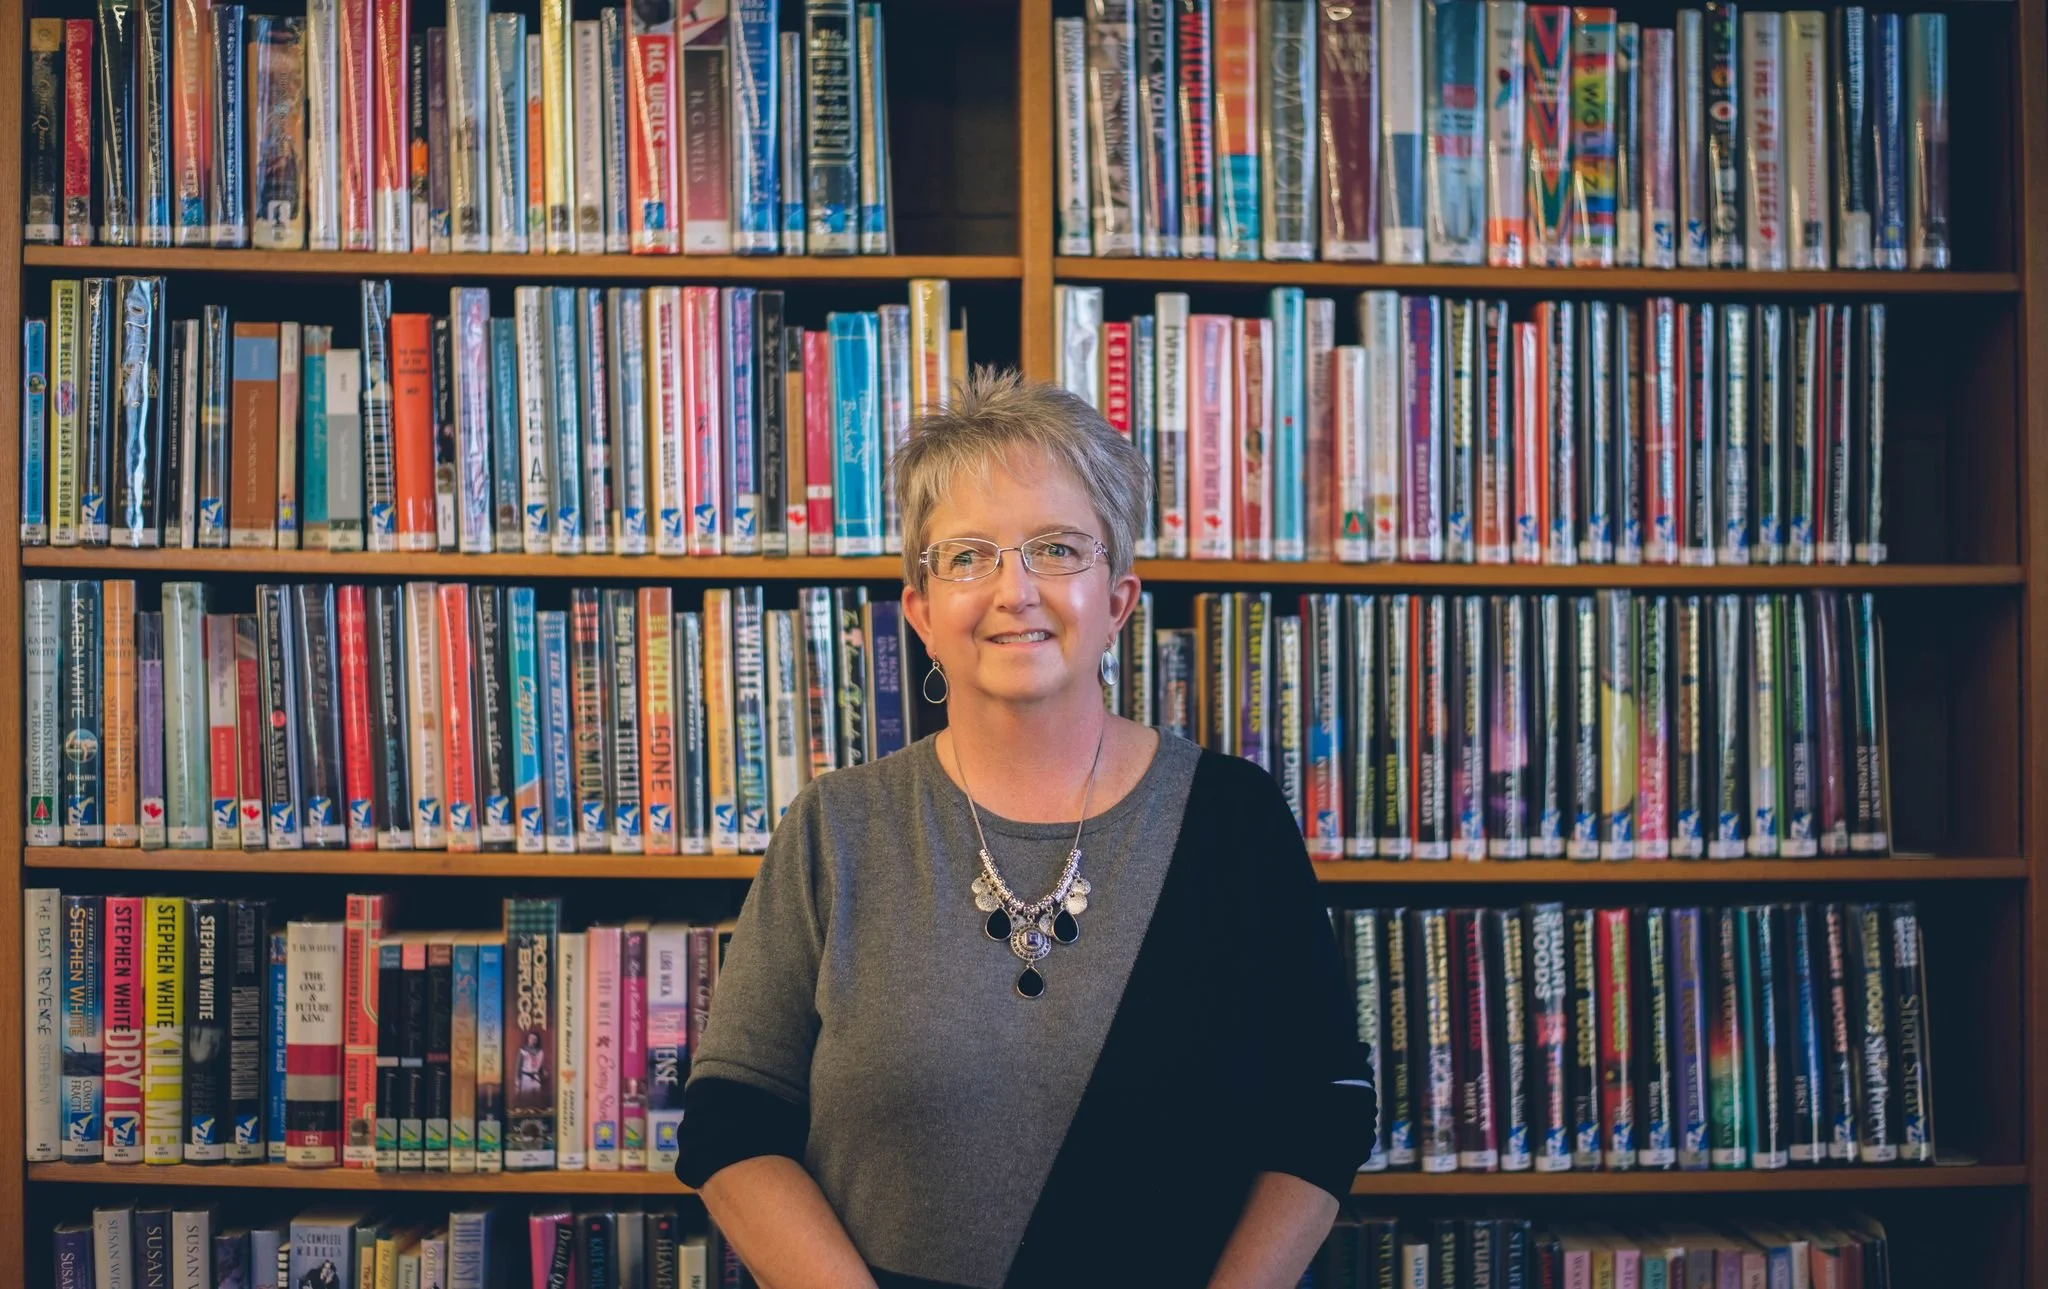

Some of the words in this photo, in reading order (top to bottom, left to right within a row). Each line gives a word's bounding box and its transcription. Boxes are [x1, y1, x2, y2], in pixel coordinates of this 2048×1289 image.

[1149, 2, 1166, 64] DICK
[1180, 12, 1207, 98] WATCH
[648, 83, 666, 141] WELLS
[1149, 72, 1166, 140] WOLF
[186, 110, 197, 149] ANDY
[690, 132, 705, 183] WELLS
[61, 289, 73, 337] REBECCA
[61, 343, 73, 376] WELLS
[1108, 331, 1126, 423] LOTTERY
[61, 423, 73, 459] YA-YAS
[61, 464, 73, 475] IN
[61, 481, 73, 517] BLOOM
[72, 598, 85, 658] KAREN
[382, 605, 394, 637] have
[483, 595, 498, 633] such
[616, 607, 634, 643] Randy
[316, 635, 328, 673] EVEN
[484, 637, 493, 649] a
[740, 625, 760, 702] WHITE
[877, 637, 889, 691] UNSPENT
[888, 636, 899, 652] AN
[316, 677, 328, 690] IF
[383, 665, 392, 696] seen
[482, 652, 502, 713] perfect
[551, 650, 561, 680] THE
[616, 646, 634, 685] Wayne
[648, 638, 669, 715] WHITE
[888, 658, 899, 692] HOUR
[72, 664, 85, 719] WHITE
[316, 691, 328, 708] IT
[552, 687, 563, 728] HEAT
[578, 658, 600, 743] HUNTER'S
[616, 686, 634, 723] White
[31, 712, 41, 747] TRADD
[43, 701, 53, 768] CHRISTMAS
[107, 696, 118, 740] SOUTH
[517, 676, 536, 756] Captiva
[1283, 688, 1298, 750] WOODS
[120, 726, 131, 779] GUESTS
[490, 720, 502, 758] wife
[651, 725, 671, 793] GONE
[107, 745, 118, 807] BATTERY
[553, 732, 565, 798] ISLANDS
[578, 748, 600, 800] MOON
[1283, 751, 1298, 796] Dirty
[1421, 753, 1433, 826] JEOPARDY
[37, 897, 52, 921] THE
[87, 907, 95, 922] NEW
[238, 908, 254, 946] STEPHEN
[349, 900, 359, 917] THE
[37, 927, 52, 960] BEST
[69, 907, 86, 981] STEPHEN
[87, 924, 95, 941] YORK
[87, 943, 95, 963] TIMES
[114, 906, 132, 977] STEPHEN
[157, 904, 175, 974] STEPHEN
[199, 915, 216, 974] STEPHEN
[312, 944, 338, 954] WHITE
[1355, 916, 1376, 981] STUART
[1389, 920, 1408, 982] STUART
[238, 947, 254, 975] WHITE
[660, 951, 674, 970] LORI
[1533, 912, 1551, 1000] WOODS
[1551, 912, 1565, 998] STUART
[1575, 921, 1592, 990] STUART
[87, 965, 95, 1009] BESTSELLING
[275, 981, 285, 1003] soft
[299, 983, 326, 993] ONCE
[302, 972, 323, 982] THE
[309, 994, 318, 1003] &
[518, 948, 532, 1031] BRUCE
[534, 935, 547, 1031] ROBERT
[598, 971, 613, 996] LORI
[660, 974, 674, 997] WICK
[37, 967, 52, 1036] REVENGE
[69, 985, 86, 1037] WHITE
[114, 983, 132, 1033] WHITE
[157, 980, 175, 1029] WHITE
[199, 979, 216, 1020] WHITE
[275, 1004, 285, 1032] place
[294, 1004, 332, 1014] FUTURE
[300, 1014, 325, 1023] KING
[598, 1001, 613, 1027] WICK
[1355, 983, 1376, 1043] WOOD
[1389, 987, 1408, 1052] WOODS
[1865, 971, 1885, 1034] WOODS
[275, 1034, 285, 1047] to
[1575, 997, 1592, 1067] WOODS
[1900, 995, 1919, 1056] Short
[40, 1044, 50, 1093] STEPHEN
[105, 1029, 140, 1087] DRY
[142, 1024, 183, 1093] KILL
[275, 1048, 285, 1072] land
[591, 1055, 616, 1089] Every
[1865, 1035, 1888, 1081] Short
[83, 1080, 93, 1112] COMPO
[1464, 1082, 1476, 1125] DIRTY
[1795, 1076, 1808, 1116] FIRST
[142, 1099, 183, 1145] ME
[108, 1220, 120, 1259] SUSAN
[186, 1225, 199, 1278] SUSAN
[454, 1221, 481, 1246] THE
[557, 1229, 573, 1269] Death
[591, 1238, 604, 1263] KATE
[146, 1226, 162, 1288] SUSAN
[454, 1251, 481, 1283] BEST
